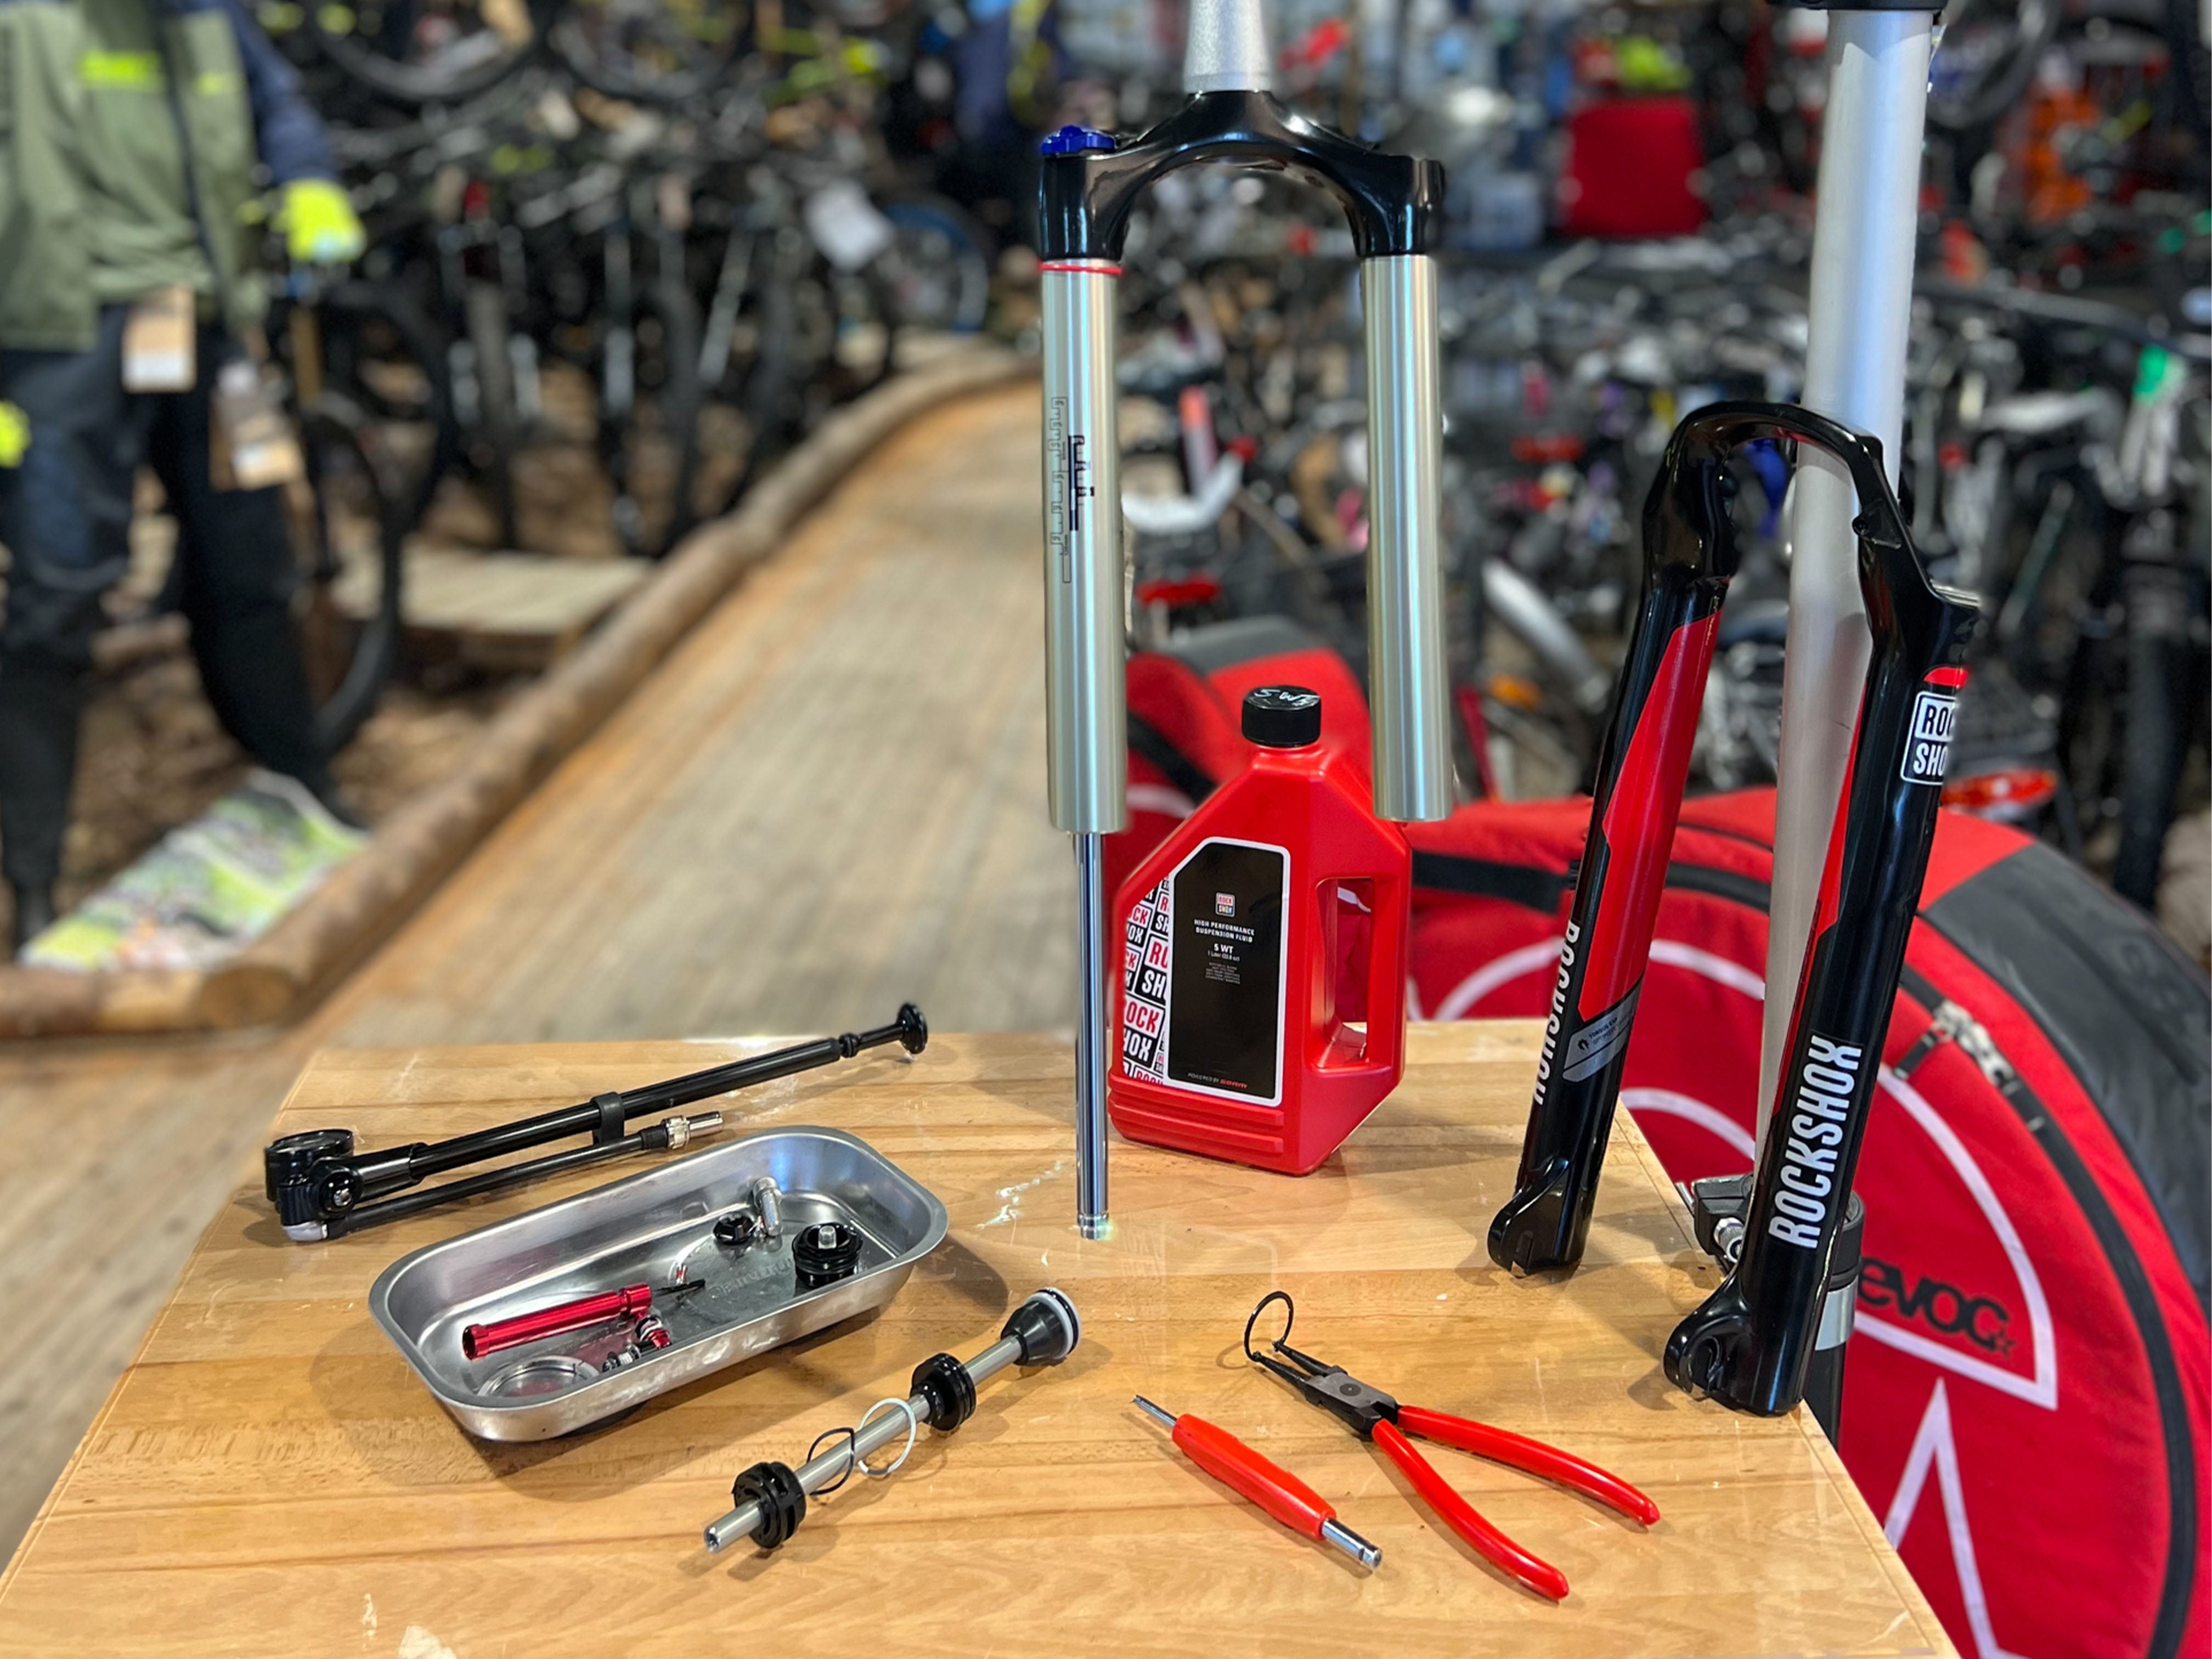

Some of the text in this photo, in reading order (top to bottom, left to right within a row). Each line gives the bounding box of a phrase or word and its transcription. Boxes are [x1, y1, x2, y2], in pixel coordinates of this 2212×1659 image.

[1913, 743, 1948, 776] SHO
[1132, 907, 1148, 925] CK
[1194, 919, 1255, 936] HIGH PERFORMANCE
[1195, 927, 1253, 943] SUSPENSION FLUID
[1214, 943, 1234, 954] 5 WT
[1142, 969, 1166, 998] SH
[1125, 1001, 1159, 1034] OCK
[1124, 1028, 1152, 1062] HOX
[1768, 1035, 1863, 1249] ROCKSHOX
